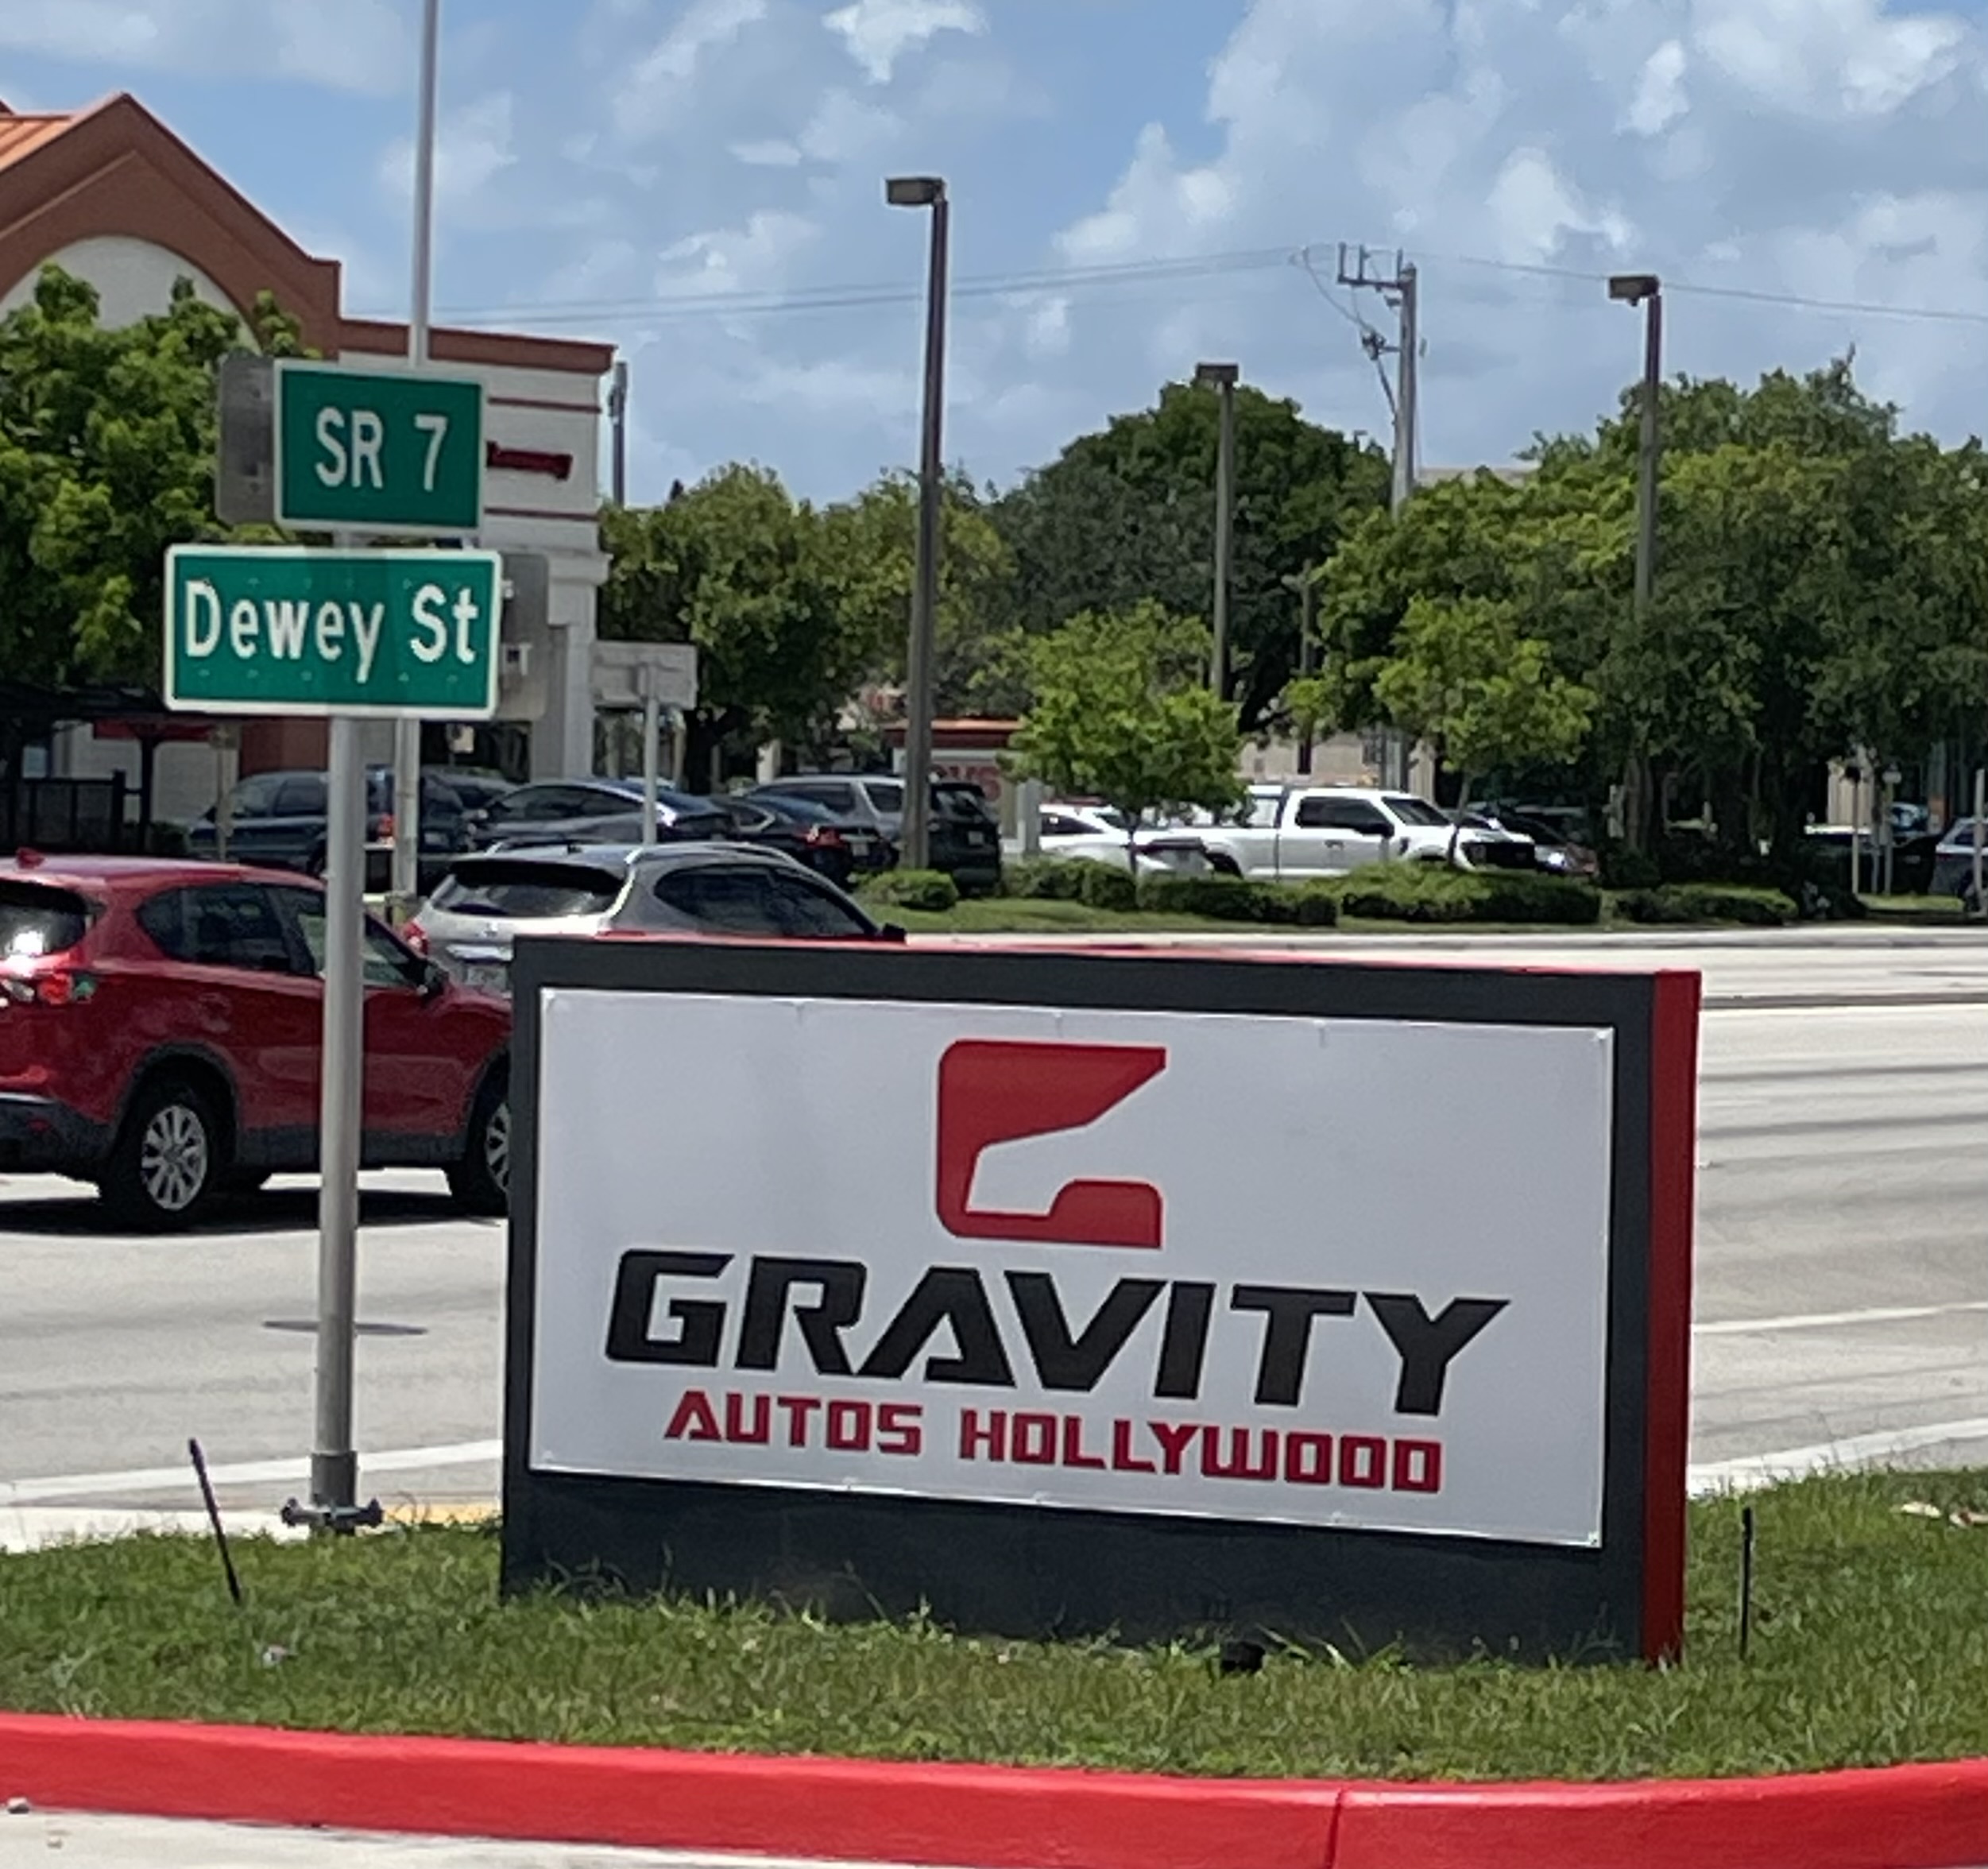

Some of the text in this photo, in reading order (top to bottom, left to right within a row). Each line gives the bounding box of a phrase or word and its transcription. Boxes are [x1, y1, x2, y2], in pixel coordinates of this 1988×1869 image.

[315, 407, 383, 488] SR
[415, 415, 447, 489] 7
[184, 580, 479, 683] Dewey St
[604, 1248, 1511, 1418] GRAVITY
[663, 1390, 1441, 1494] AUTOS HOLLYWOOD
